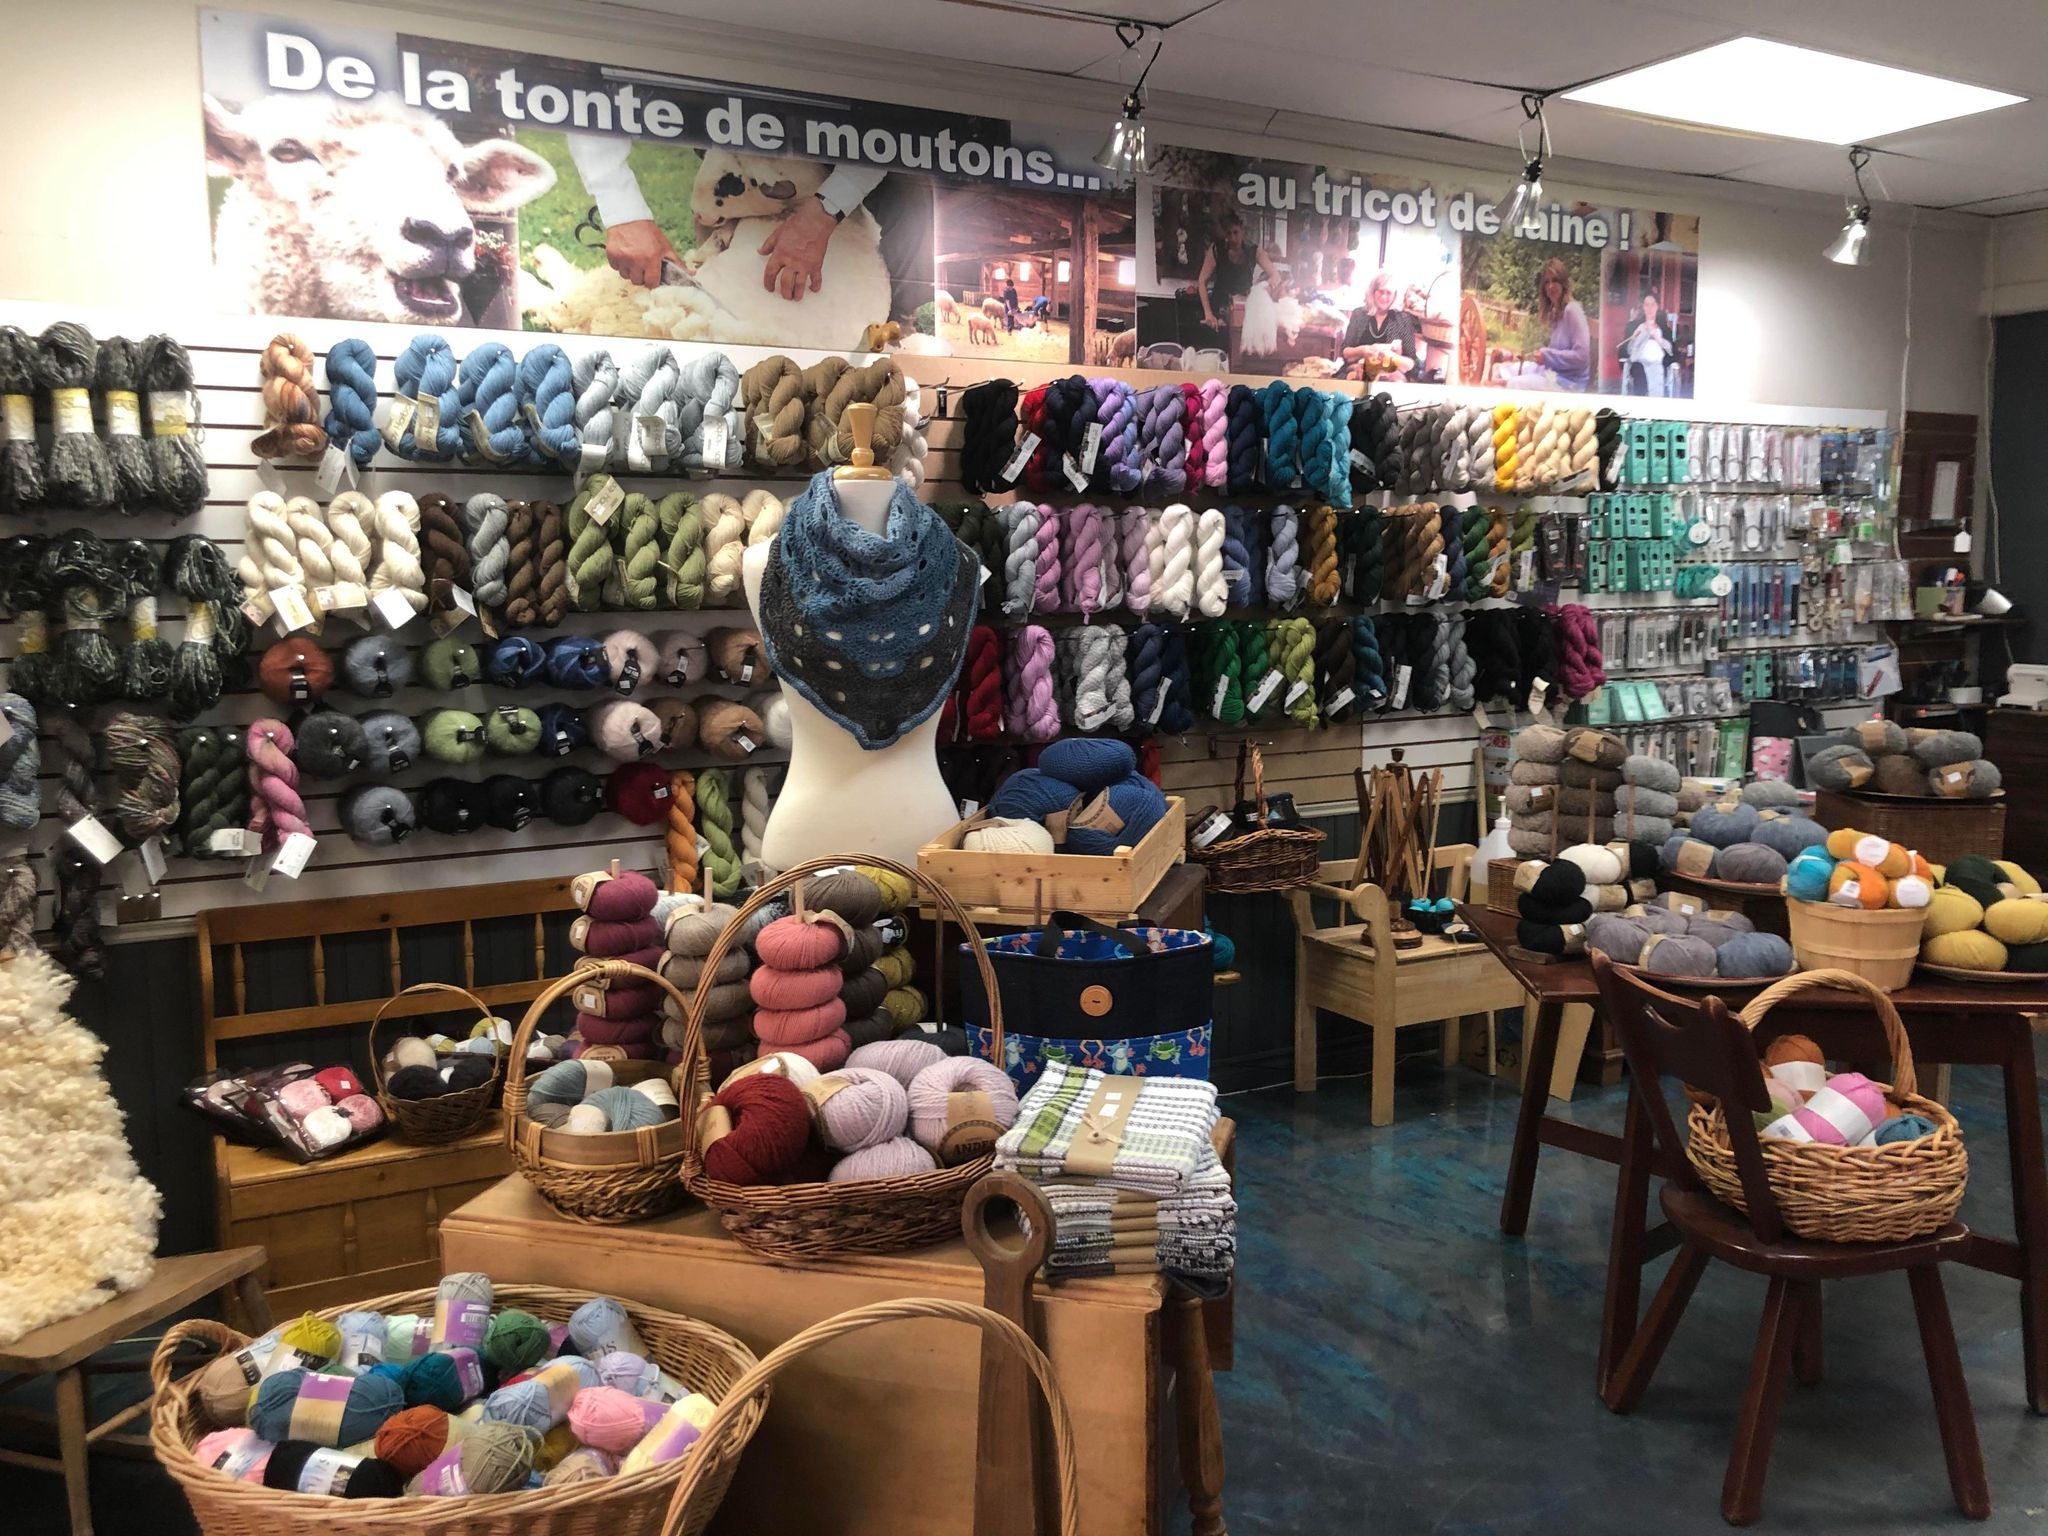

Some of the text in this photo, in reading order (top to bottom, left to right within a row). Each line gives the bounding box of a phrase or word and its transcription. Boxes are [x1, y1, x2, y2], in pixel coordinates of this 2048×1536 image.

[265, 32, 1101, 191] De la tonte de moutons...
[1237, 172, 1297, 211] au
[1312, 174, 1438, 228] tricot
[1449, 191, 1500, 236] de
